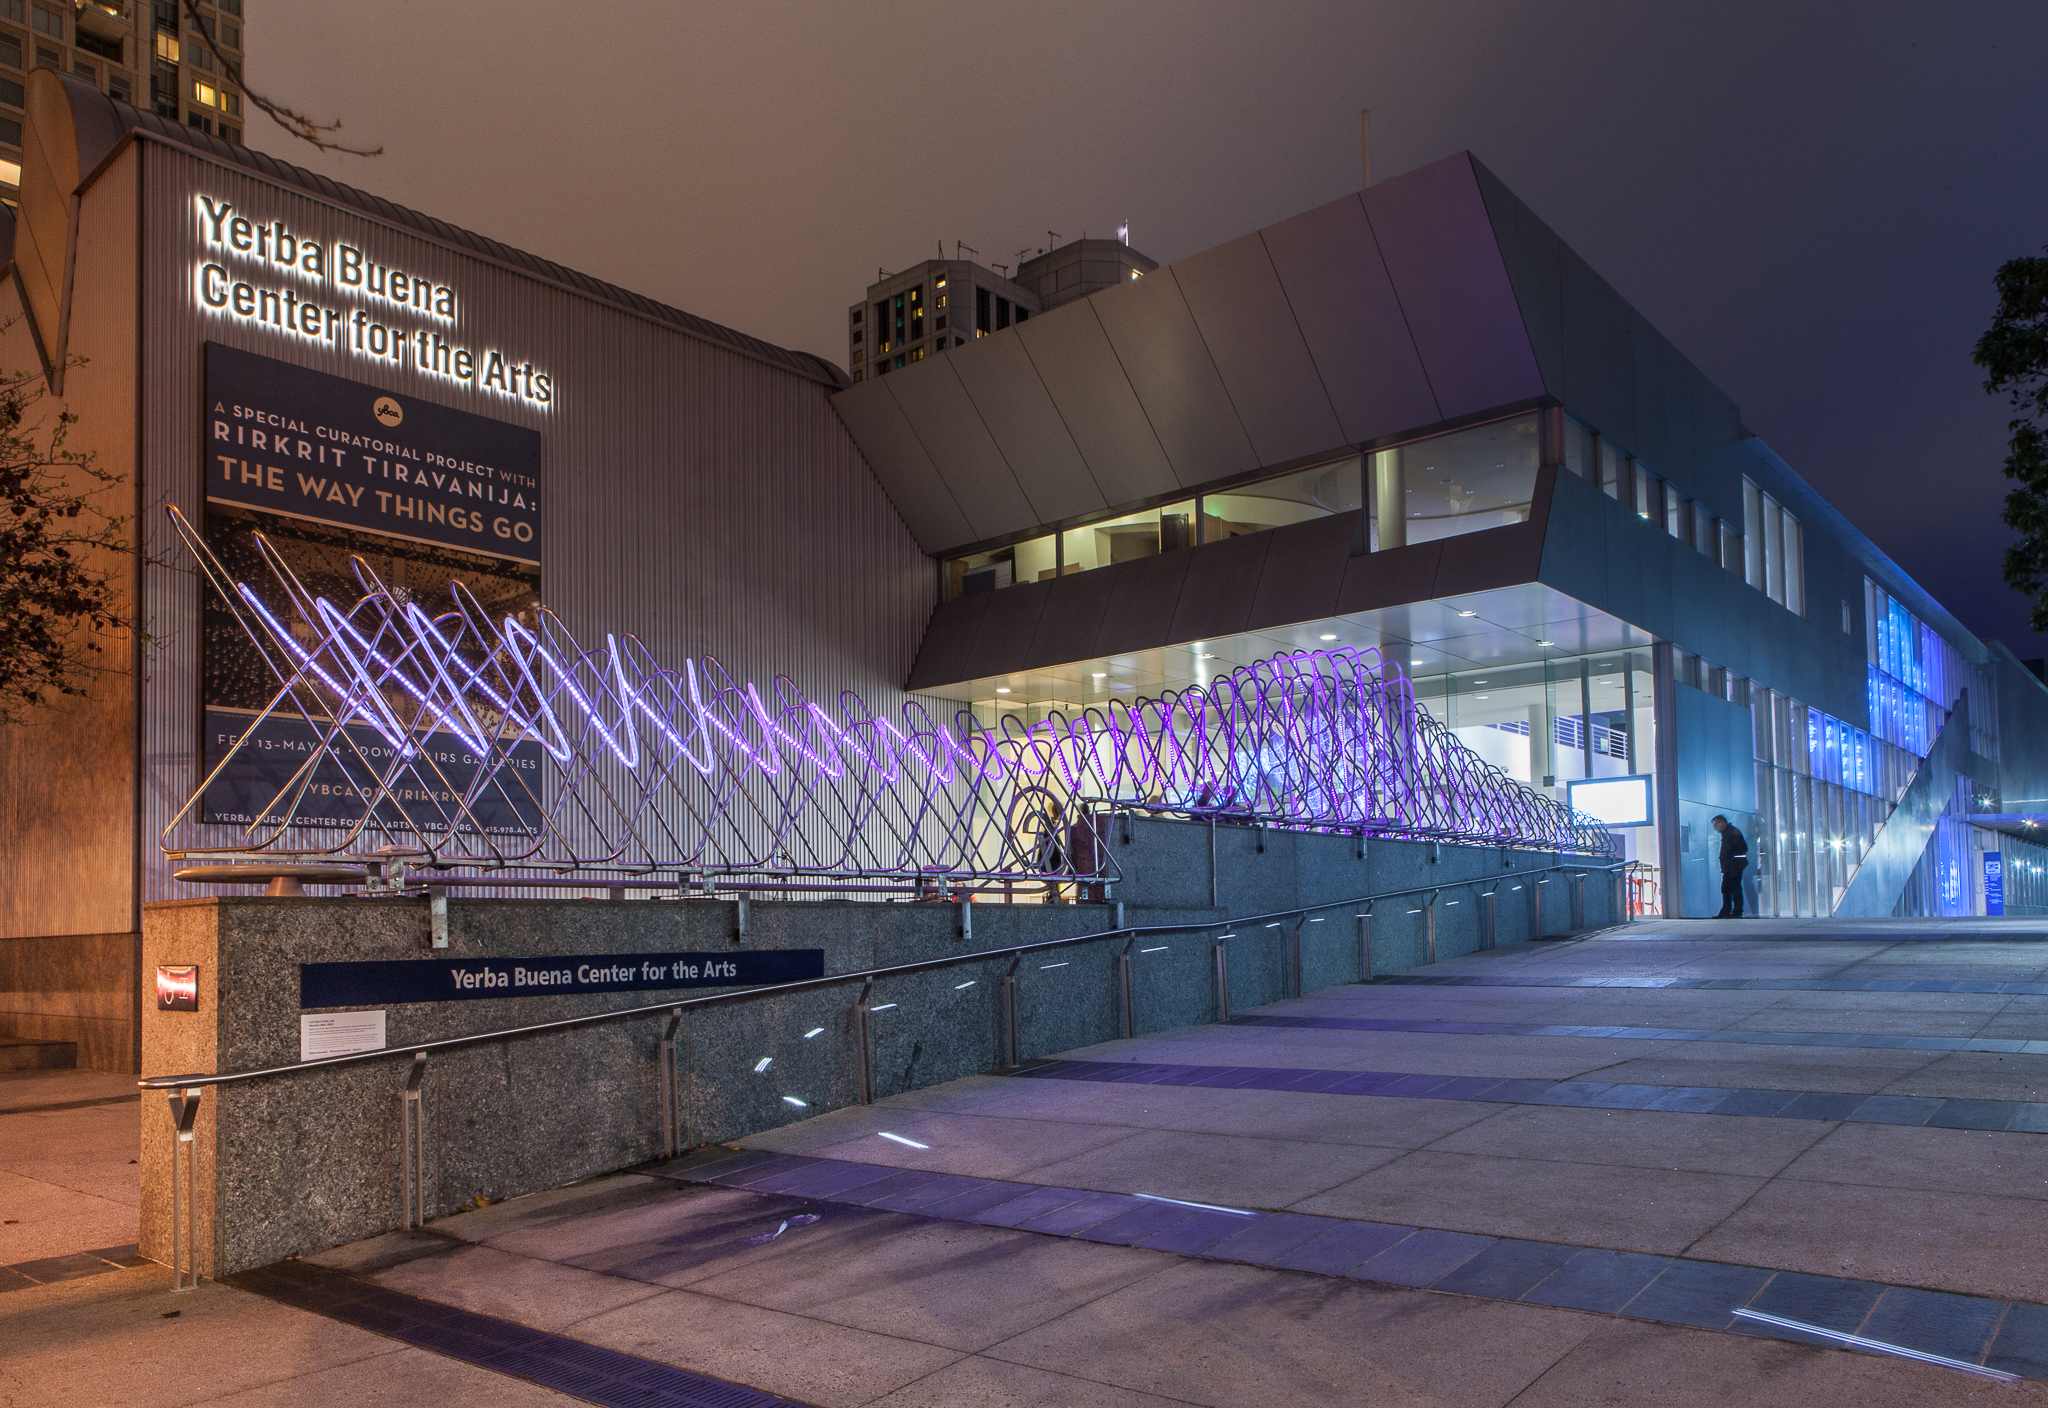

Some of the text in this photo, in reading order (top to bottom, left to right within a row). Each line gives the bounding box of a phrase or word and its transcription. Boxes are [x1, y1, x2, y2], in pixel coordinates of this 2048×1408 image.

[199, 195, 455, 320] Yerba Buena
[201, 263, 551, 403] Center for the Arts
[214, 401, 536, 489] A SPECIAL CURATORIAL PROJECT WITH
[377, 404, 400, 418] ybca
[214, 420, 536, 511] RIRKRIT TIRAVANIJA:
[217, 455, 533, 543] THE WAY THINGS GO
[214, 813, 252, 823] YERBA
[255, 814, 293, 825] UEN
[295, 816, 337, 827] CENTER
[364, 819, 382, 828] TH
[386, 820, 410, 830] ARTS
[451, 960, 737, 989] Yerba Buena Center for the Arts
